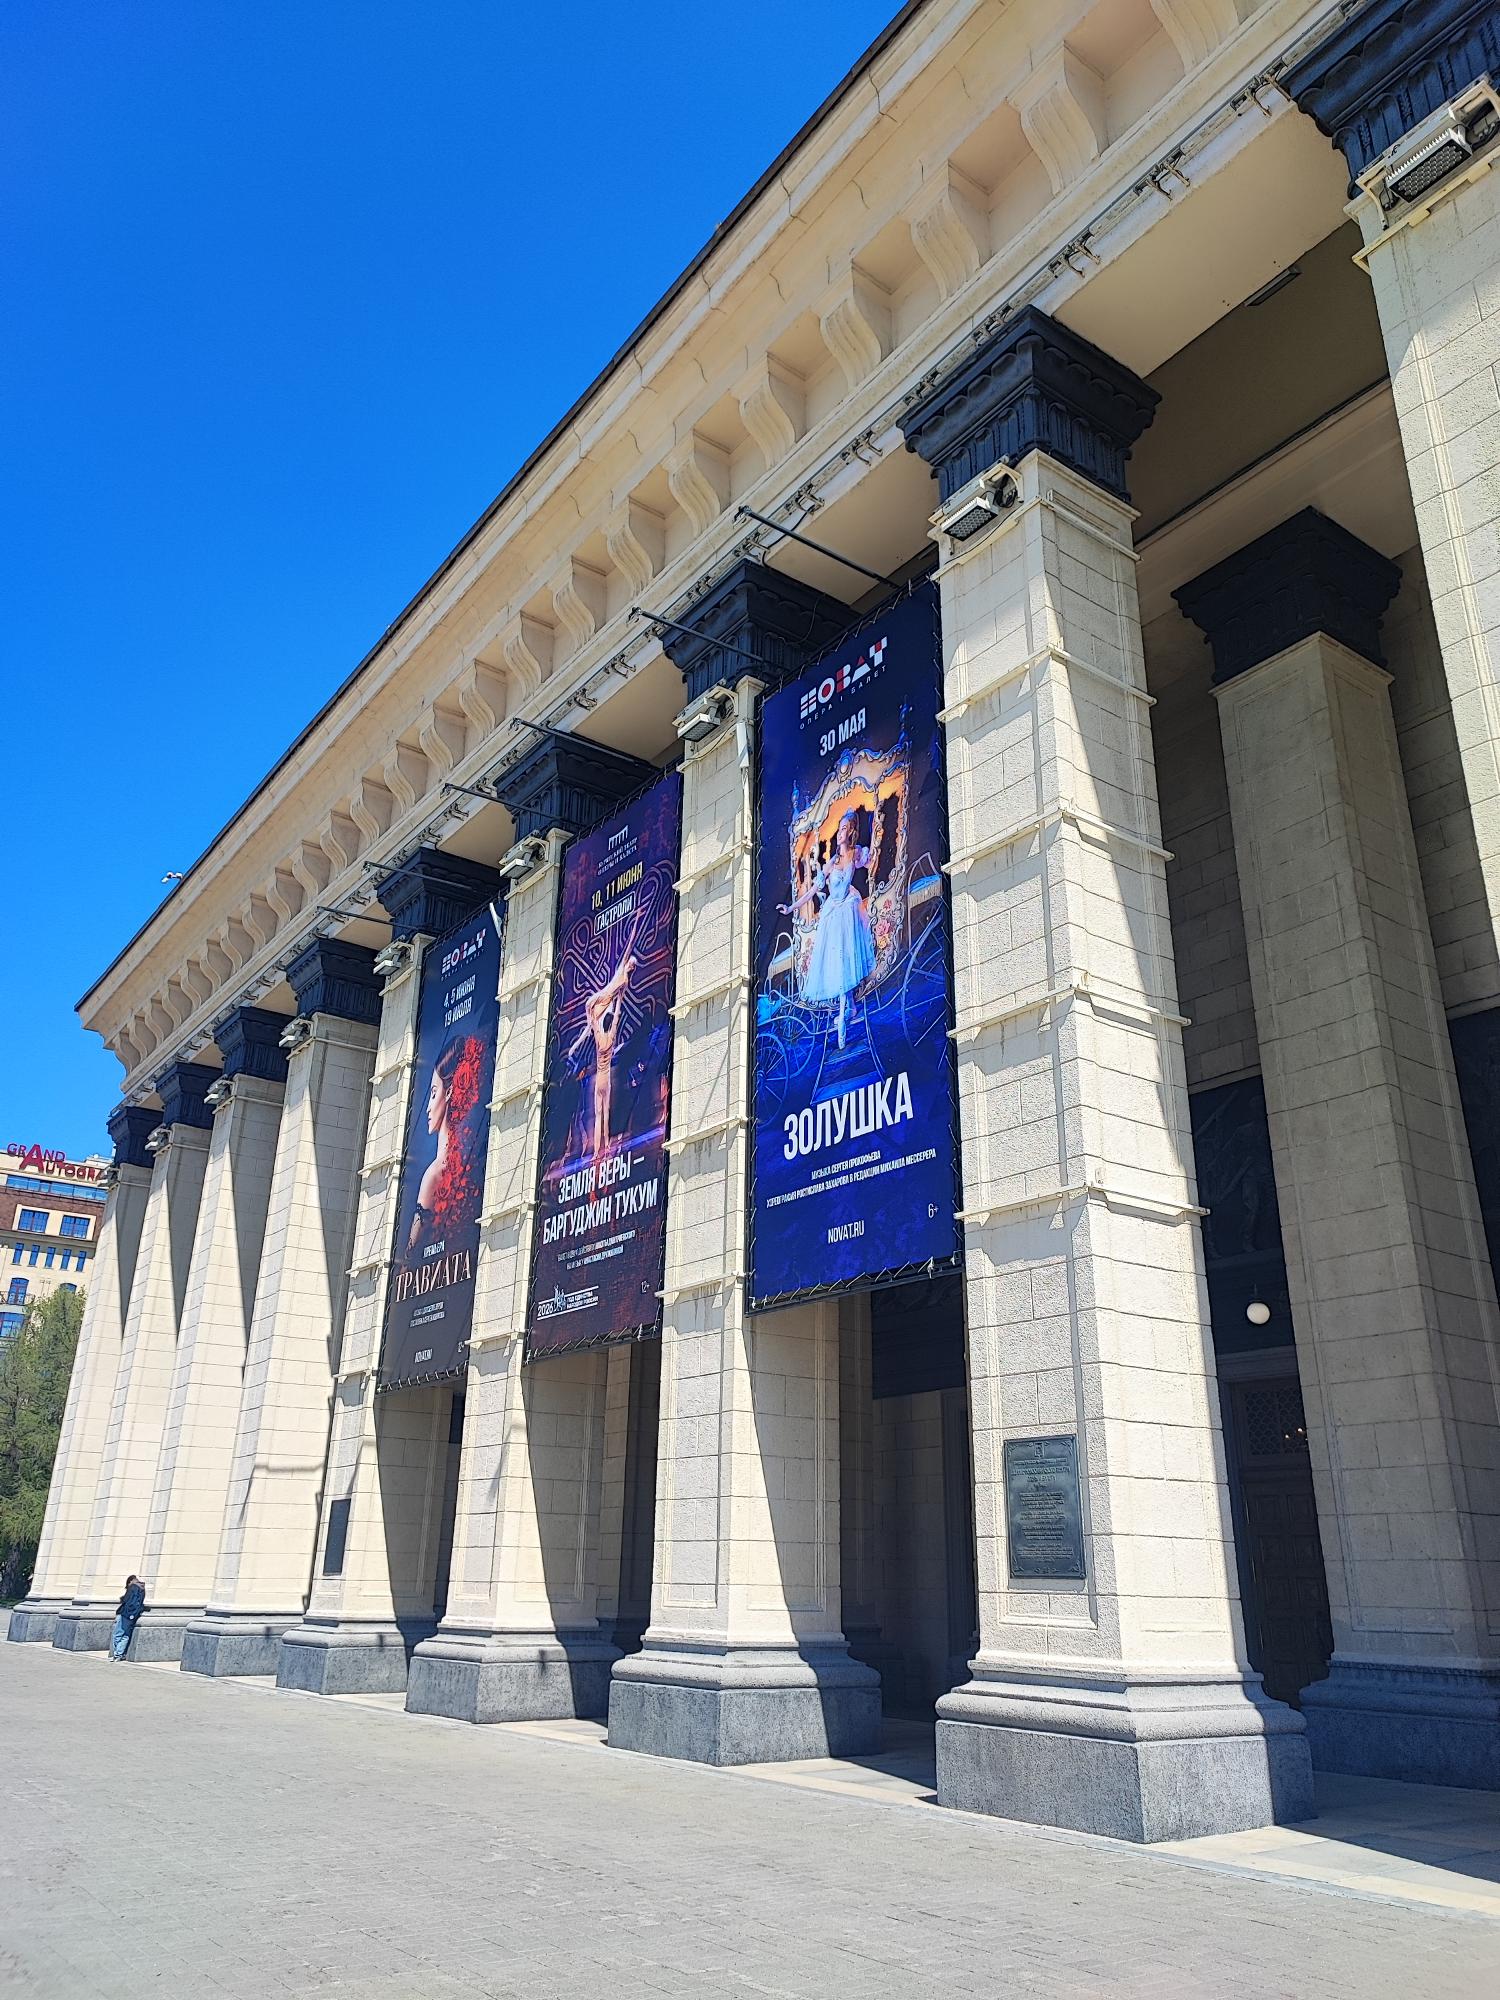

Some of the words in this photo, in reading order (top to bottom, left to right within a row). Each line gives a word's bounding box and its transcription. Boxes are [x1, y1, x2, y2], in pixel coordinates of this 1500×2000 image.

[800, 704, 833, 730] ОПЕРА
[851, 665, 886, 694] БАЛЕТ
[819, 729, 836, 756] 30
[838, 707, 866, 745] МАЯ
[592, 889, 603, 910] 10,
[606, 882, 615, 901] 11
[617, 861, 643, 894] ИЮНЯ
[597, 896, 632, 930] ГАСТРОЛИ
[444, 1009, 452, 1027] 19
[783, 1071, 914, 1161] ЗОЛУШКА
[6, 1143, 66, 1174] GRAND
[558, 1166, 595, 1204] ЗЕМЛЯ
[598, 1151, 631, 1187] ВЕРЫ
[811, 1166, 831, 1180] МУЗЫКА
[831, 1161, 849, 1174] СЕРГЕЯ
[848, 1150, 881, 1168] ПРОКОФЬЕВА
[825, 1174, 849, 1190] ЗАХАРОВА
[853, 1165, 880, 1182] РЕДАКЦИИ
[879, 1156, 906, 1174] МИХАИЛА
[905, 1148, 937, 1165] МЕССЕРЕРА
[543, 1197, 611, 1245] БАРГУДЖИН
[614, 1177, 658, 1221] ТУКУМ
[827, 1219, 865, 1244] NOVAT.RU
[927, 1203, 939, 1218] 6+
[395, 1249, 471, 1303] ТРАВИАТА
[537, 1301, 553, 1316] 2026
